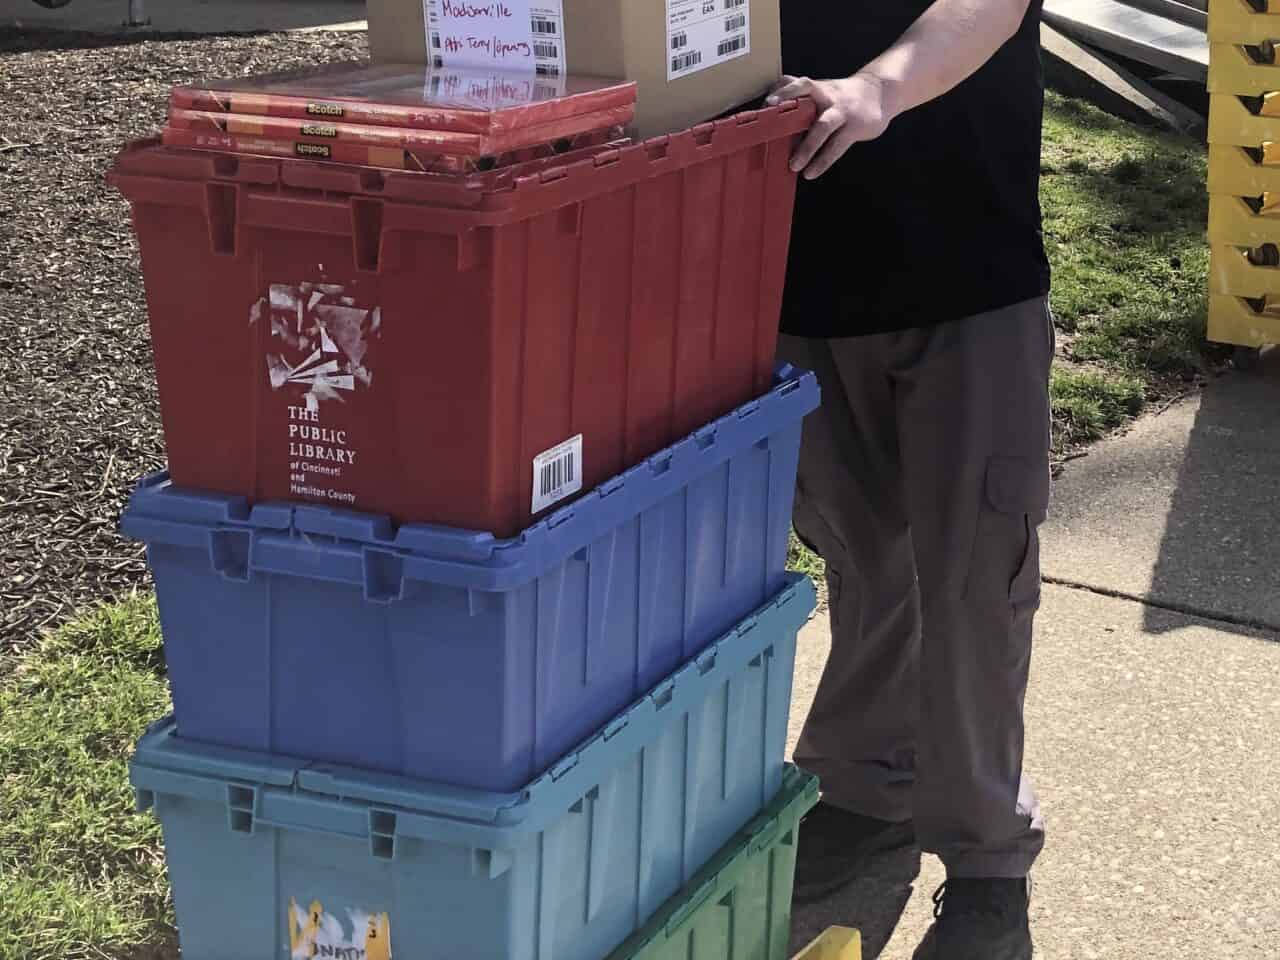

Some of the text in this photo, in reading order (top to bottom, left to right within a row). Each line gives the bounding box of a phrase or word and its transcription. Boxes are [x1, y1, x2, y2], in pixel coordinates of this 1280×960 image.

[308, 103, 343, 115] Scotch
[303, 125, 336, 136] Scotch
[297, 143, 329, 156] Scotch
[288, 405, 319, 422] THE
[289, 425, 346, 444] PUBLIC
[290, 443, 355, 464] LIBRARY
[290, 462, 341, 476] of Cincinnati
[290, 474, 305, 482] and
[290, 484, 356, 504] Hamilton County
